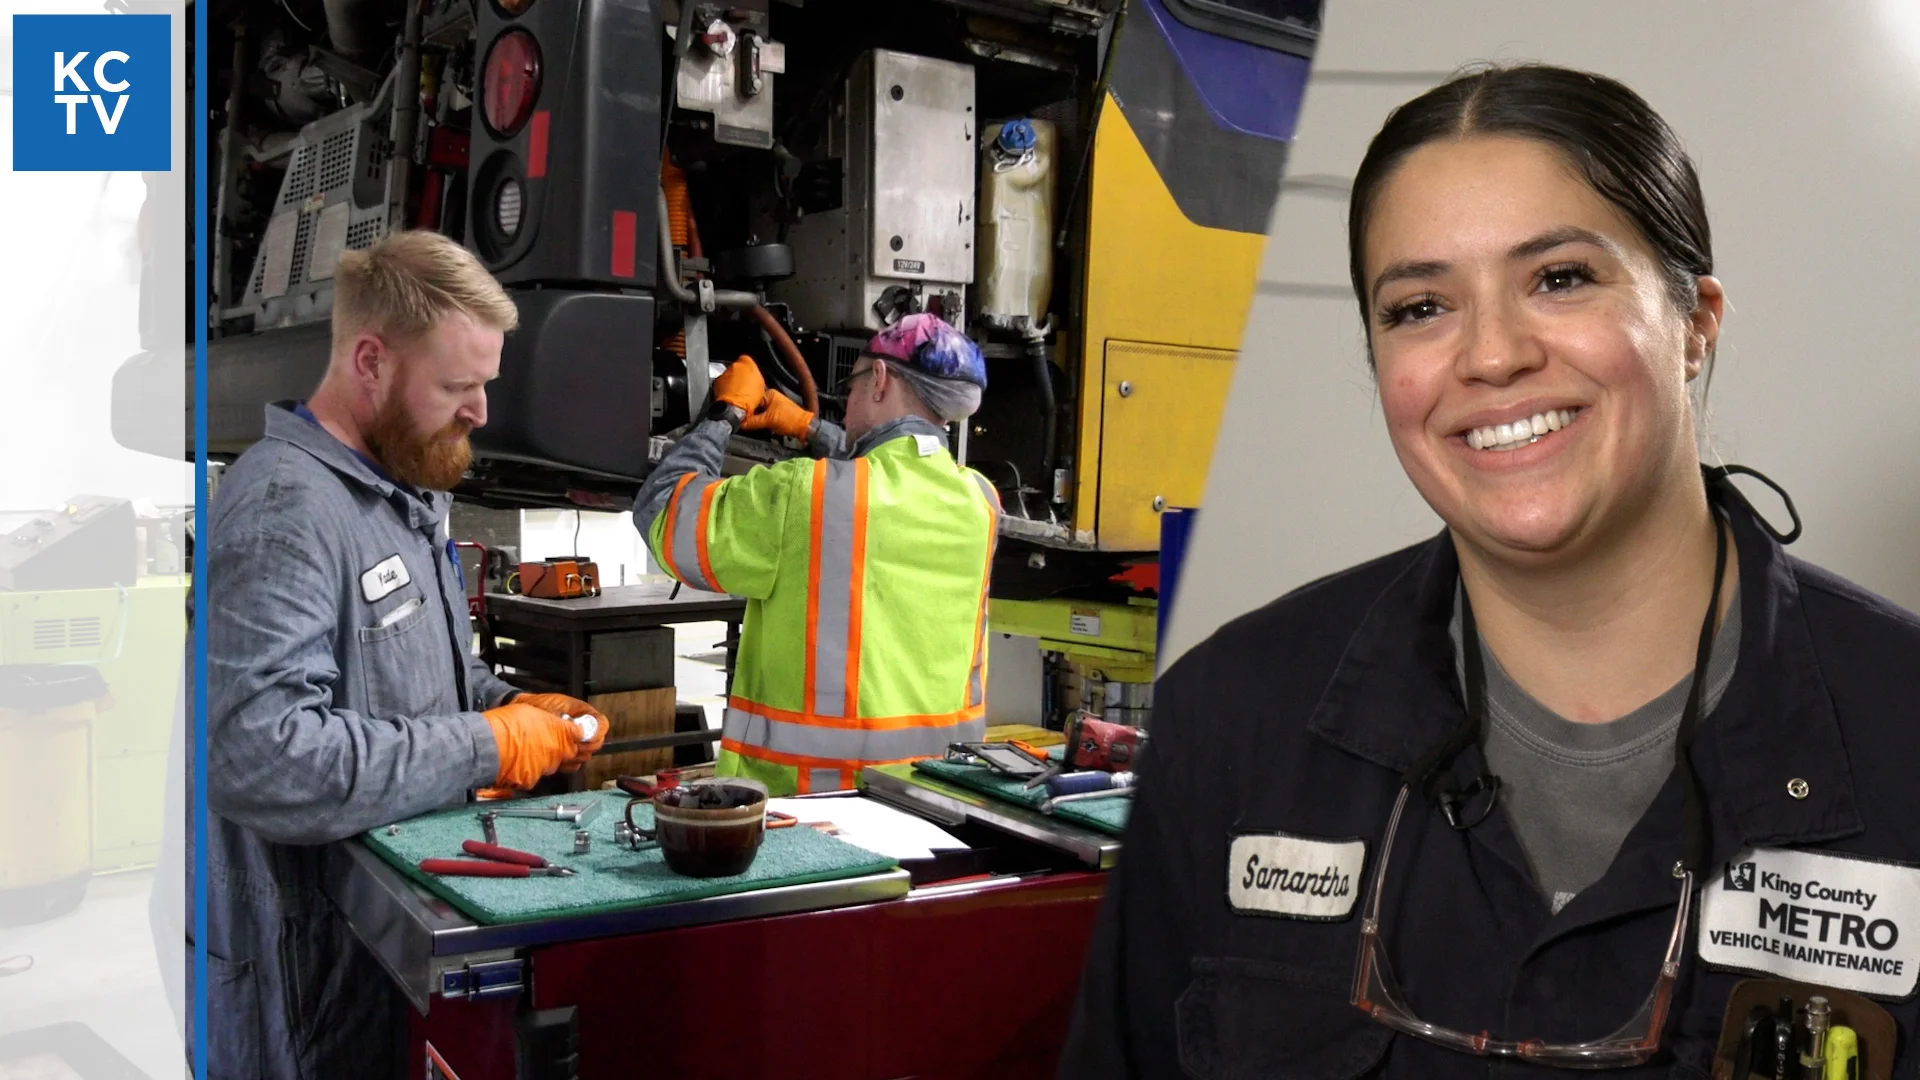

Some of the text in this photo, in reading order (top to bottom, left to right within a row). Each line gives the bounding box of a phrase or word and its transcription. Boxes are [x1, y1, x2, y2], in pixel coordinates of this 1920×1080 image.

[1242, 853, 1350, 898] Samantha
[1761, 871, 1878, 911] King County
[1758, 897, 1900, 951] METRO
[1709, 930, 1904, 976] VEHICLE MAINTENANCE
